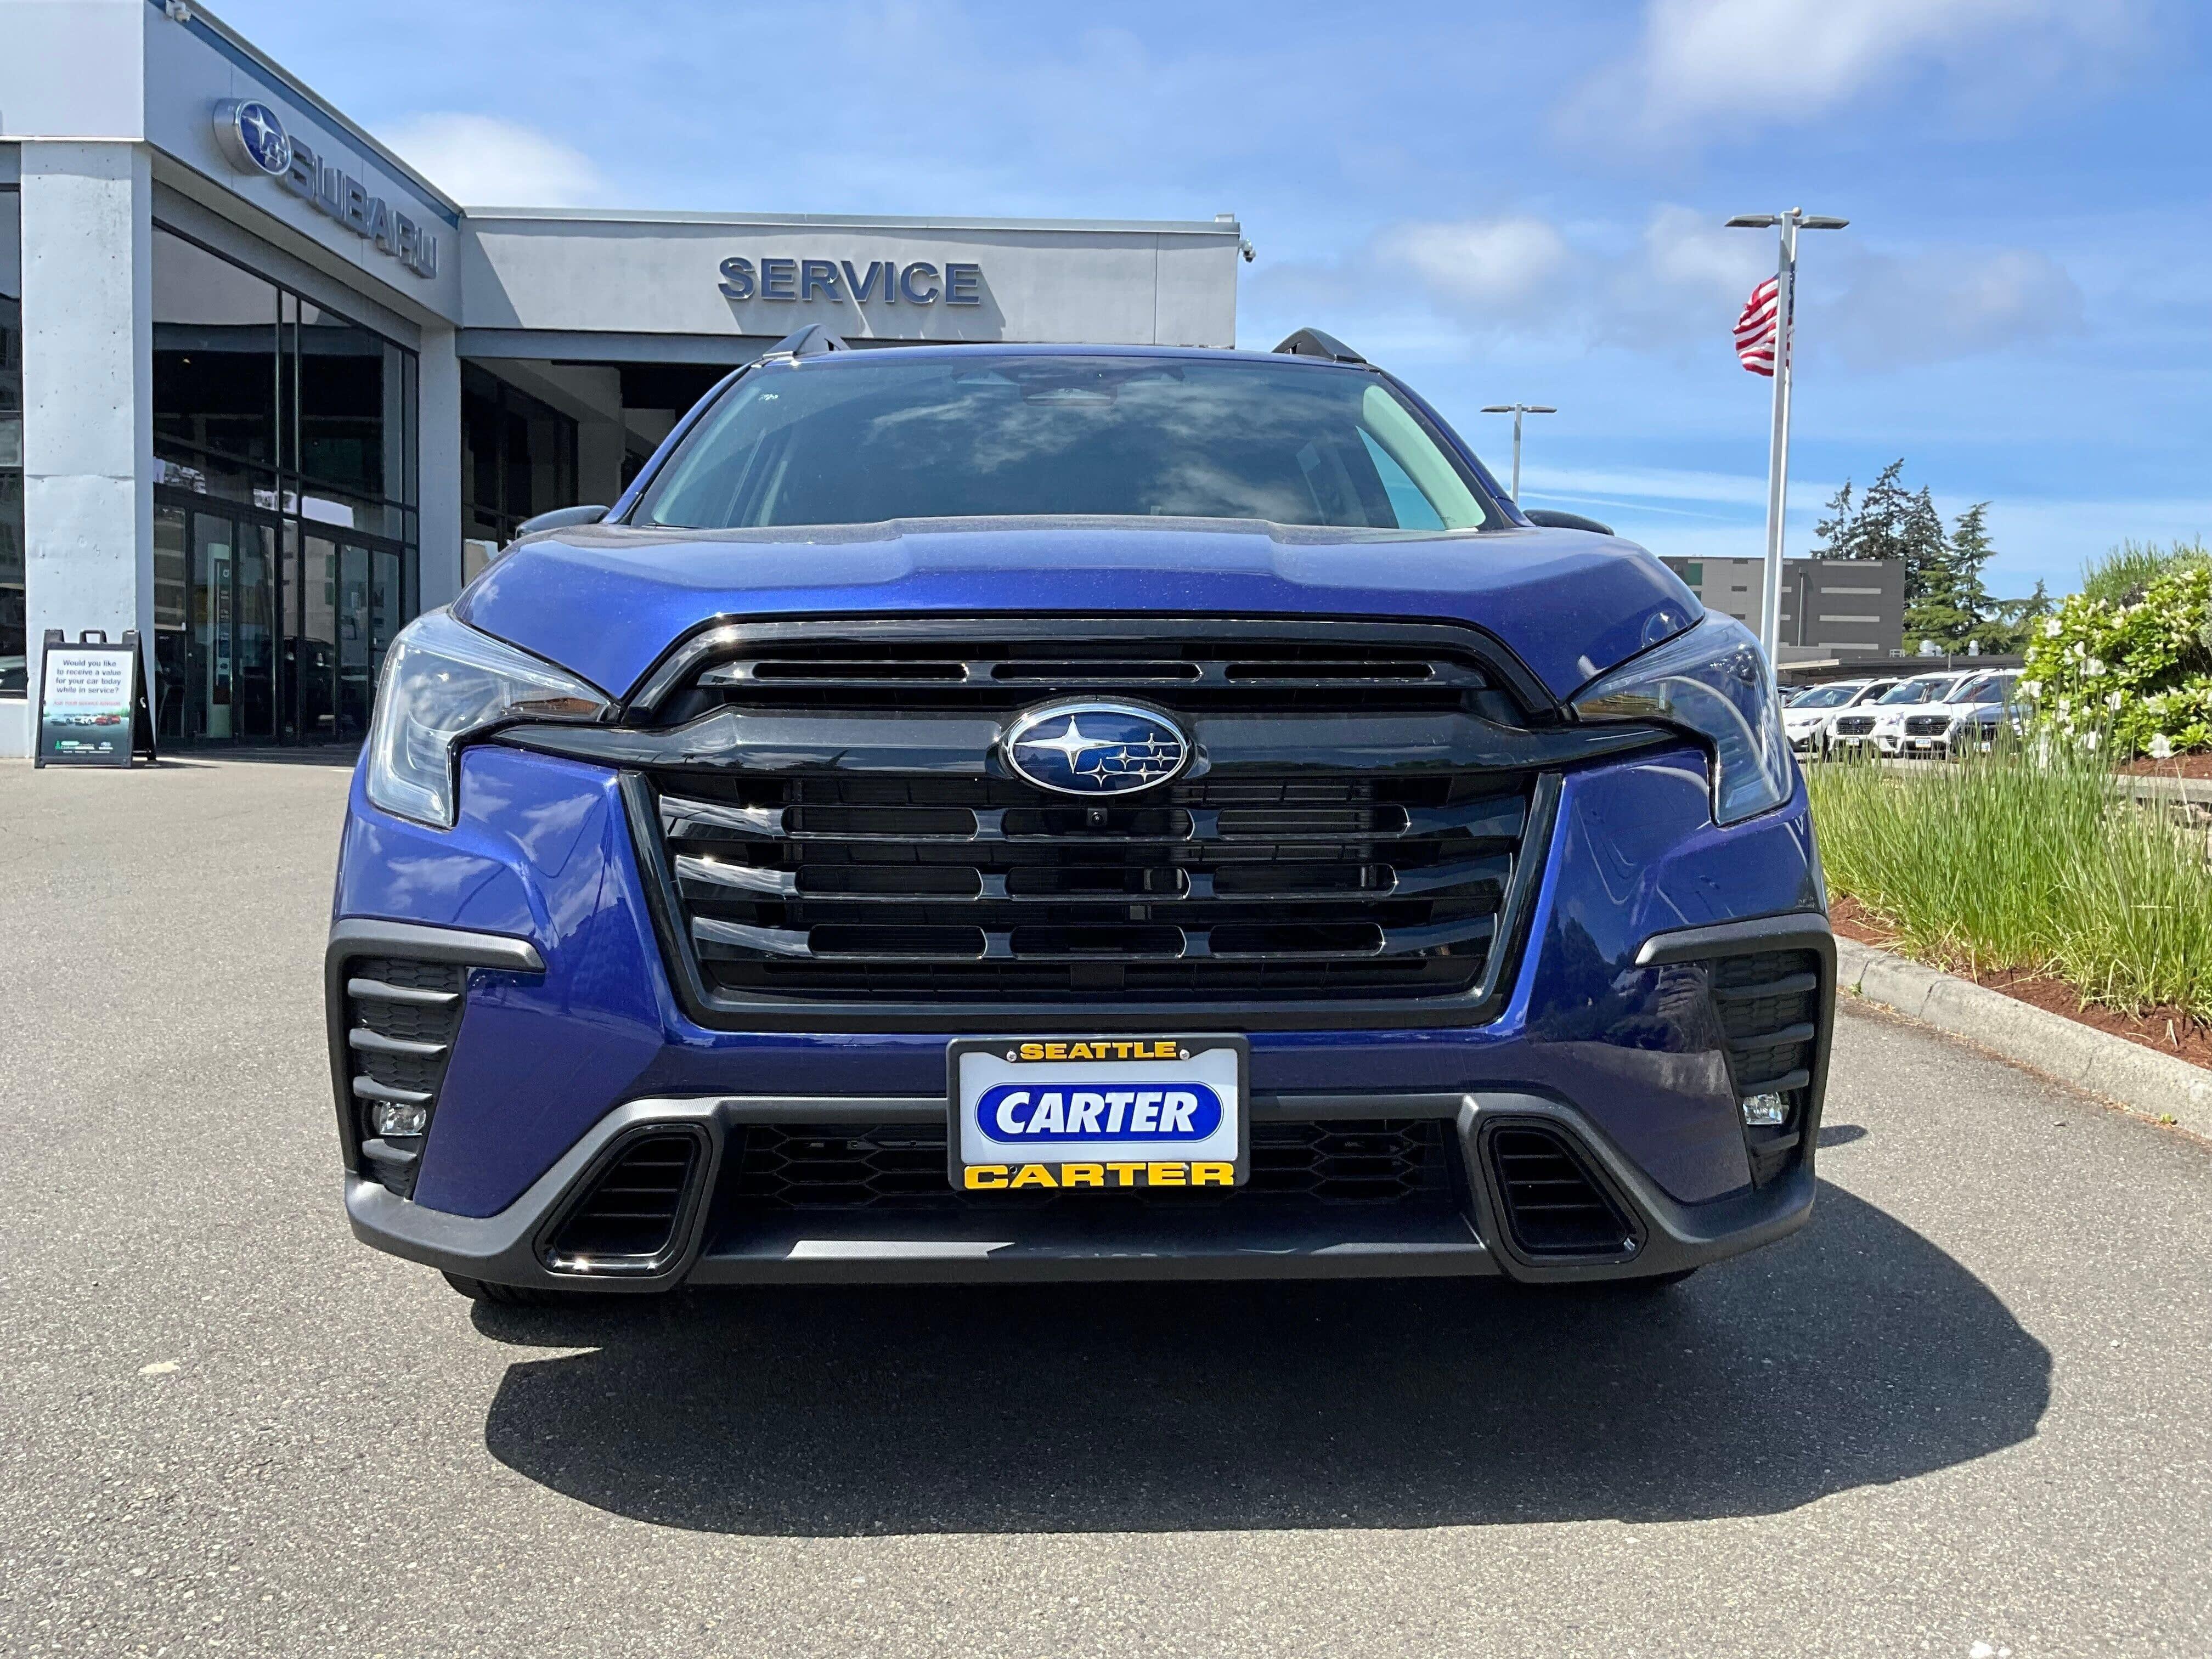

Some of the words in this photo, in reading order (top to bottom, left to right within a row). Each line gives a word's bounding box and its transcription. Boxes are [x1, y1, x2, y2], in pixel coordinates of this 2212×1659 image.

[285, 135, 438, 279] SUBARU
[718, 257, 979, 304] SERVICE
[101, 678, 121, 686] today
[1020, 1041, 1177, 1060] SEATTLE
[996, 1091, 1198, 1134] CARTER
[964, 1163, 1234, 1189] CARTER
